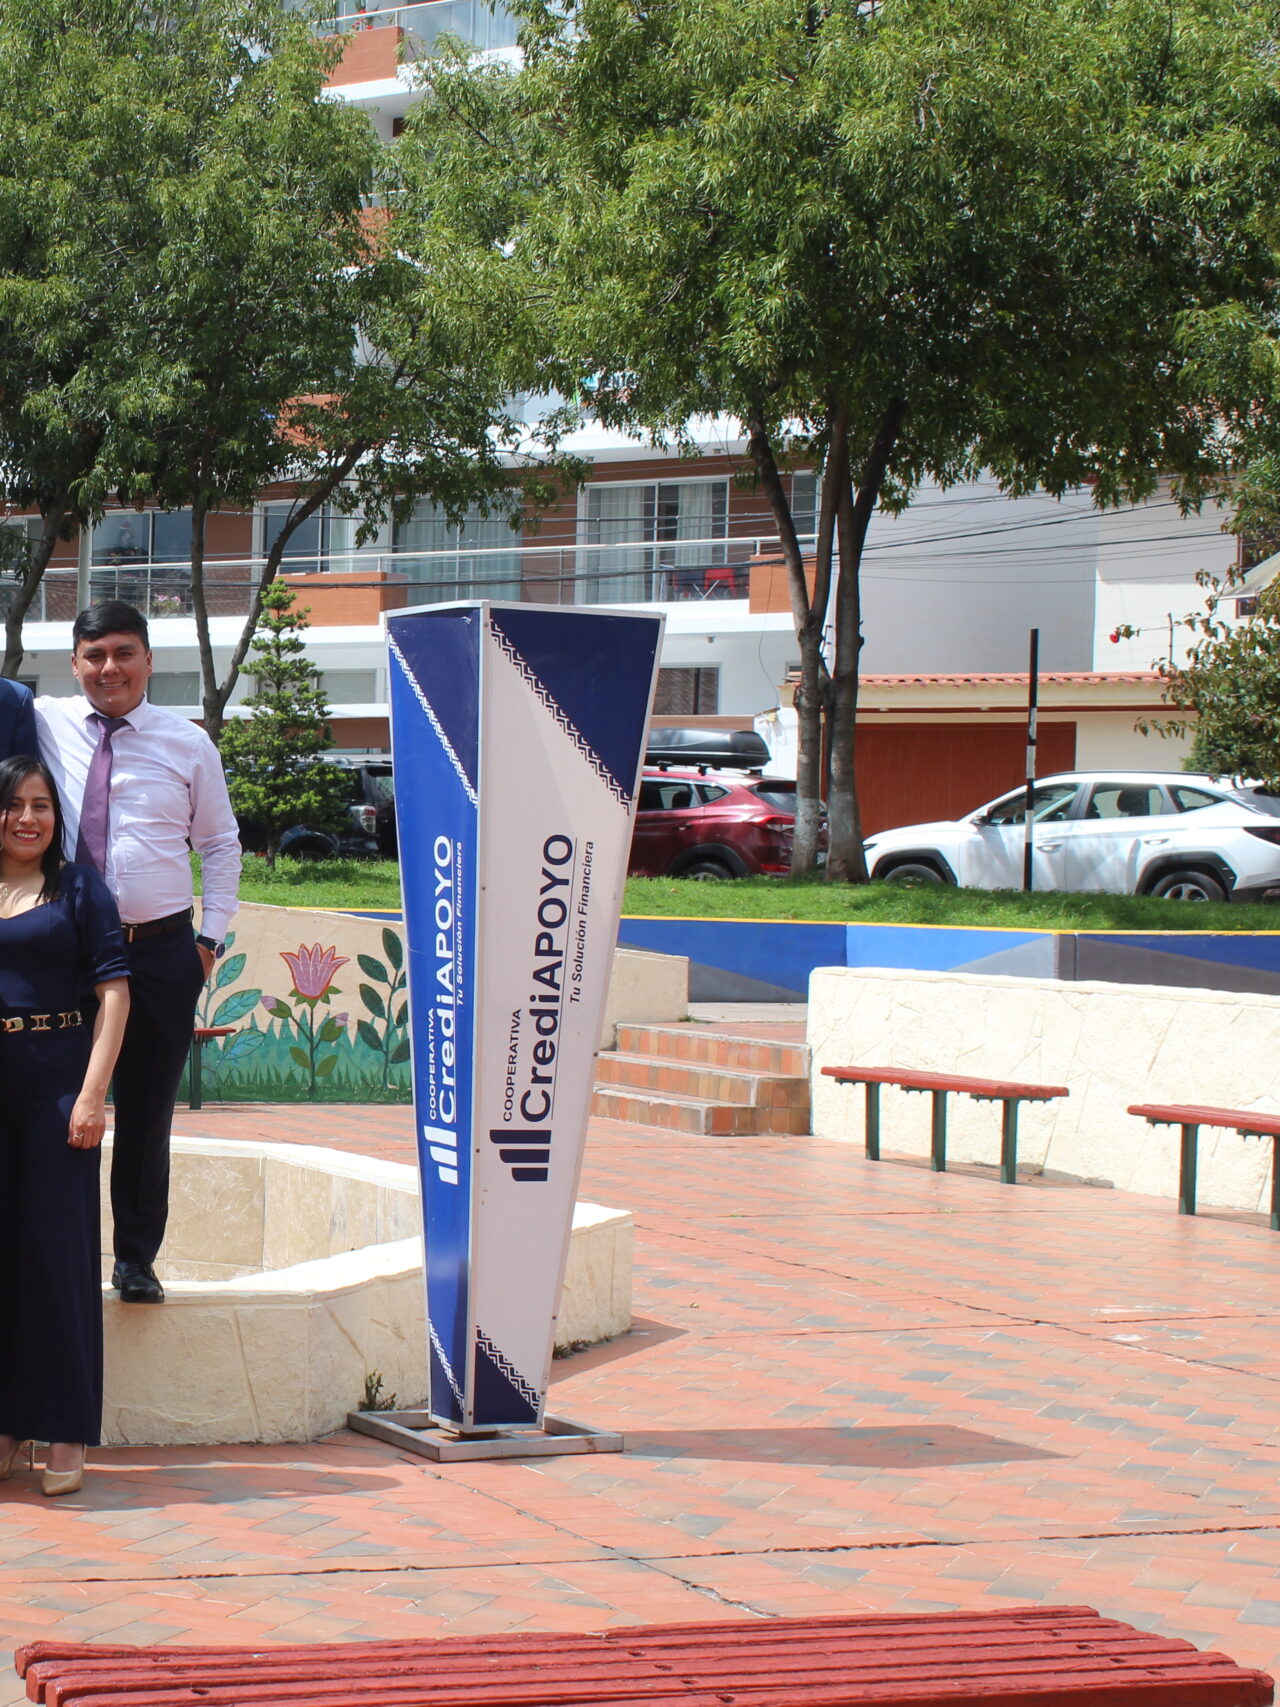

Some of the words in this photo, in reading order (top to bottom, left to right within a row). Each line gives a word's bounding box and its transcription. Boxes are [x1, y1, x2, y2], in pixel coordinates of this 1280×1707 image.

[577, 840, 594, 916] Financiera
[433, 835, 455, 1124] CrediAPOYO
[520, 834, 573, 1123] CrediAPOYO
[570, 987, 581, 1003] Tu
[571, 919, 587, 982] Solución
[456, 990, 464, 1006] Tu
[427, 1007, 437, 1120] COOPERATIVA
[503, 1008, 522, 1122] COOPERATIVA
